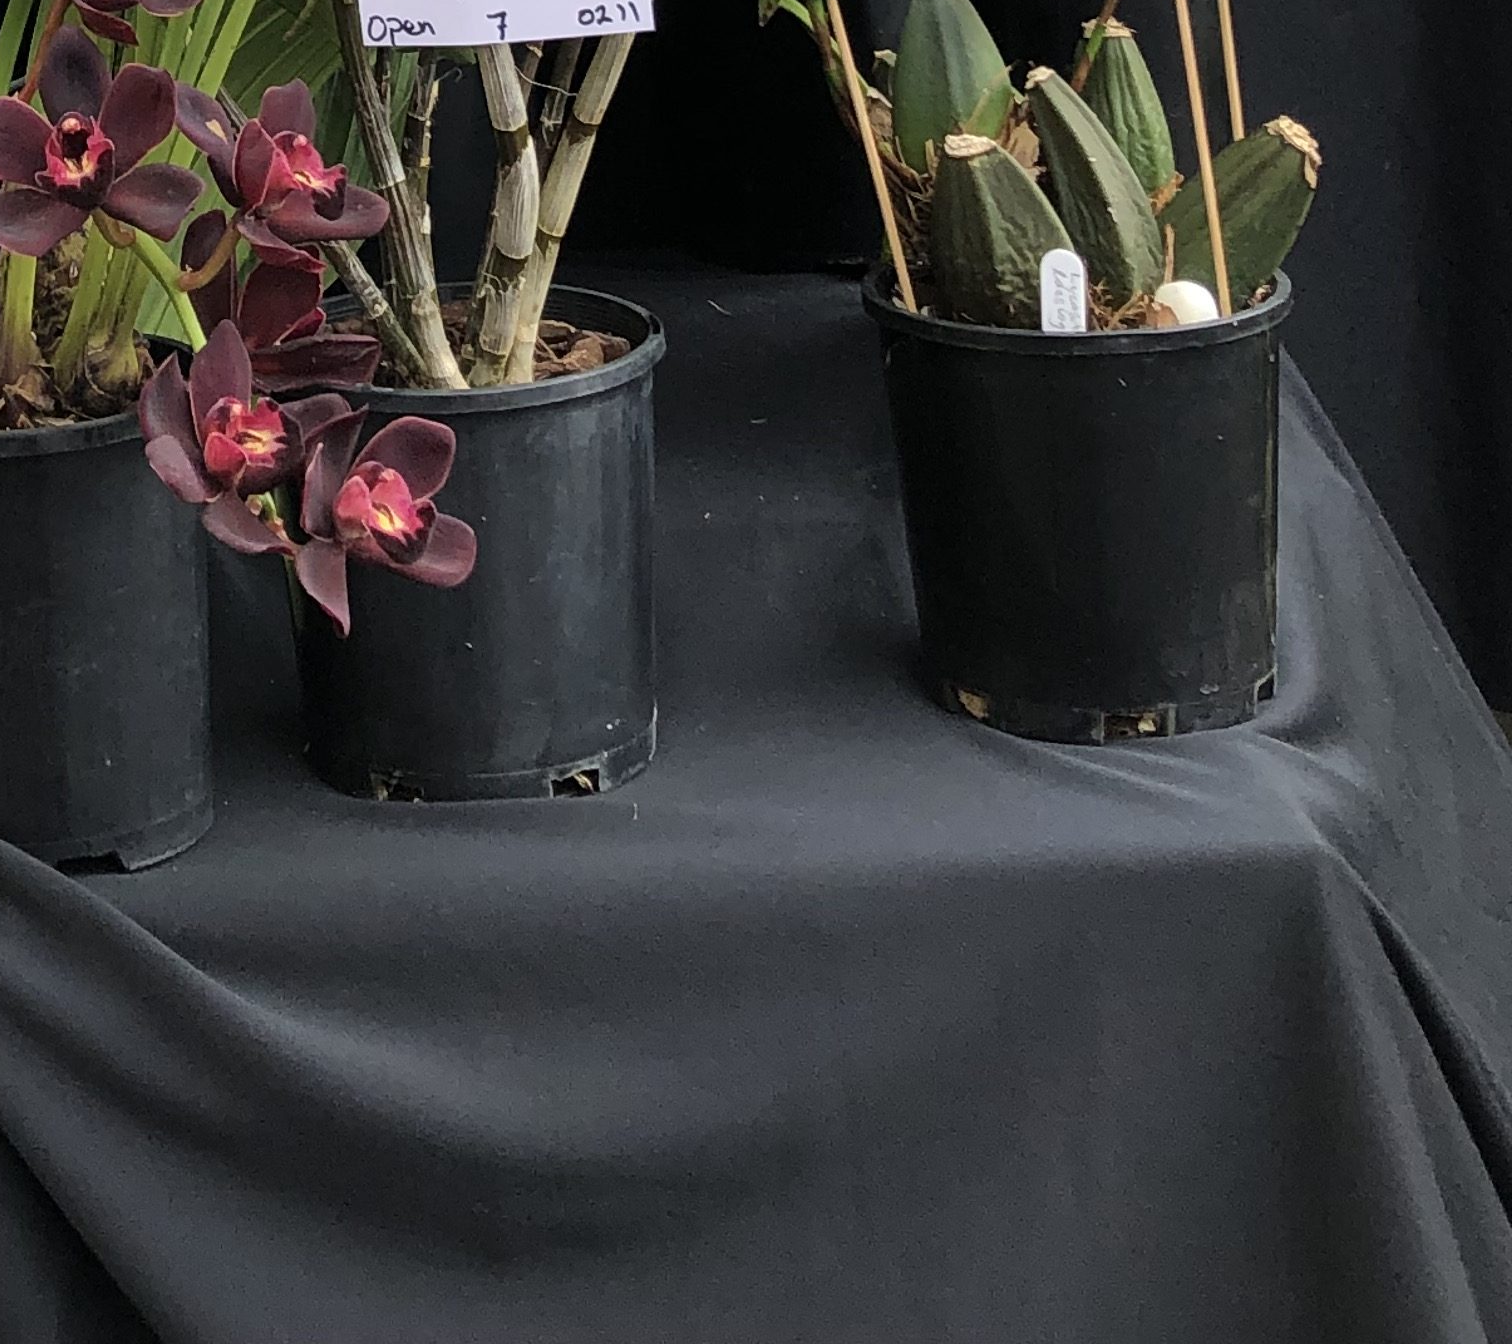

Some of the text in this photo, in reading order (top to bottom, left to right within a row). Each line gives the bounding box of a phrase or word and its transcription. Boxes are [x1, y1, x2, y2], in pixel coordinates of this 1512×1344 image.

[367, 1, 640, 46] Open 7 0211
